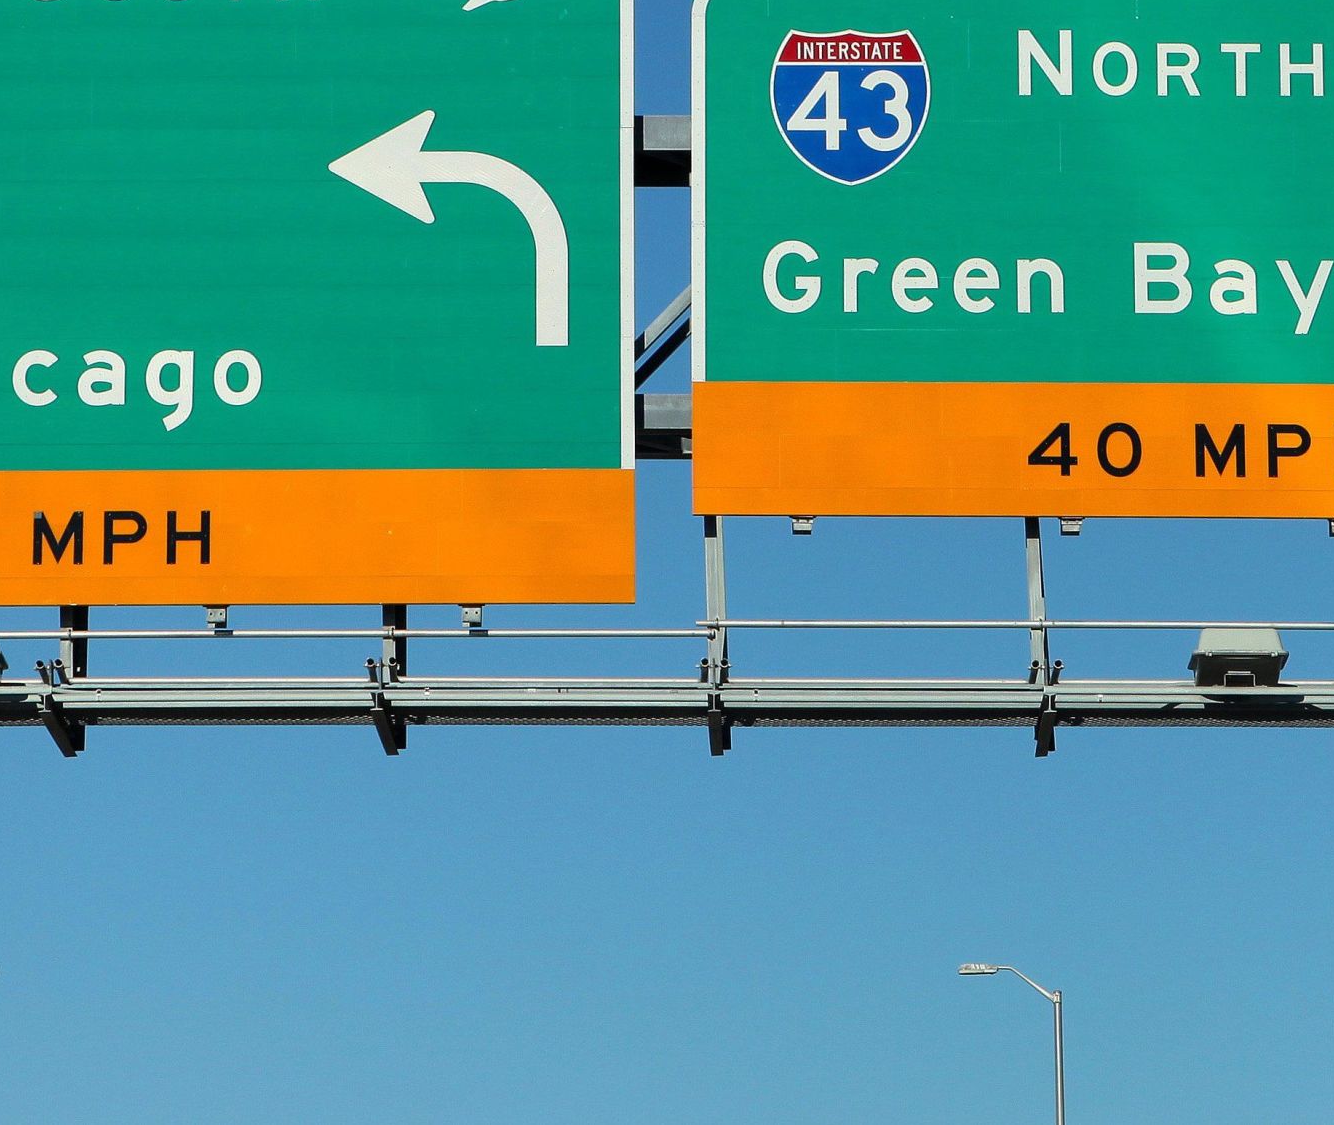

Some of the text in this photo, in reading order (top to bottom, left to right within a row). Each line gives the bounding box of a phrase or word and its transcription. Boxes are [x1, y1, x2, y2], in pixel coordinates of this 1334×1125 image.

[796, 41, 903, 62] INTERSTATE
[1018, 29, 1324, 97] NORTH
[786, 70, 914, 152] 43
[762, 240, 1334, 335] Green Bay
[1027, 422, 1143, 478] 40
[32, 510, 211, 566] MPH
